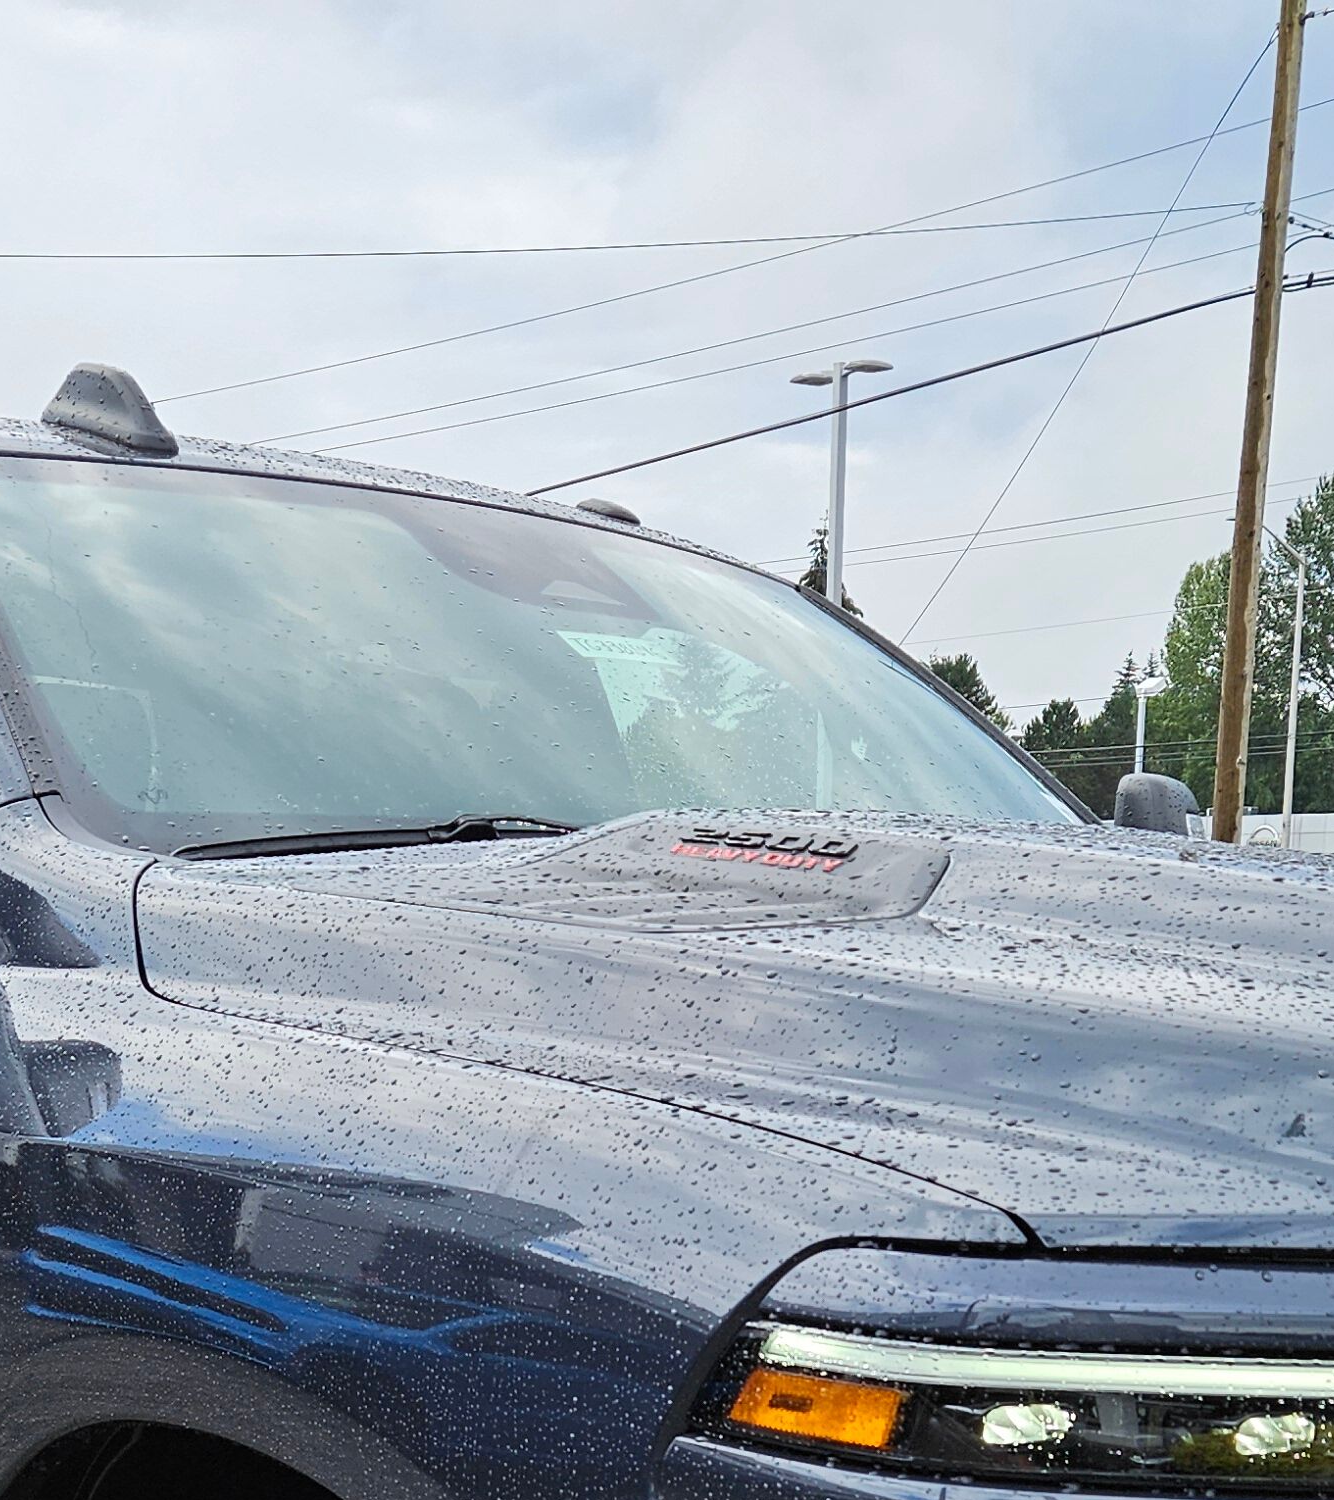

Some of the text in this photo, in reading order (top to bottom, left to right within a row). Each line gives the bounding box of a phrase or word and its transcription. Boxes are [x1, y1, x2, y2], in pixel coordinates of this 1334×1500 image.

[670, 842, 845, 873] HEAVY DUTY
[679, 828, 859, 858] 2500
